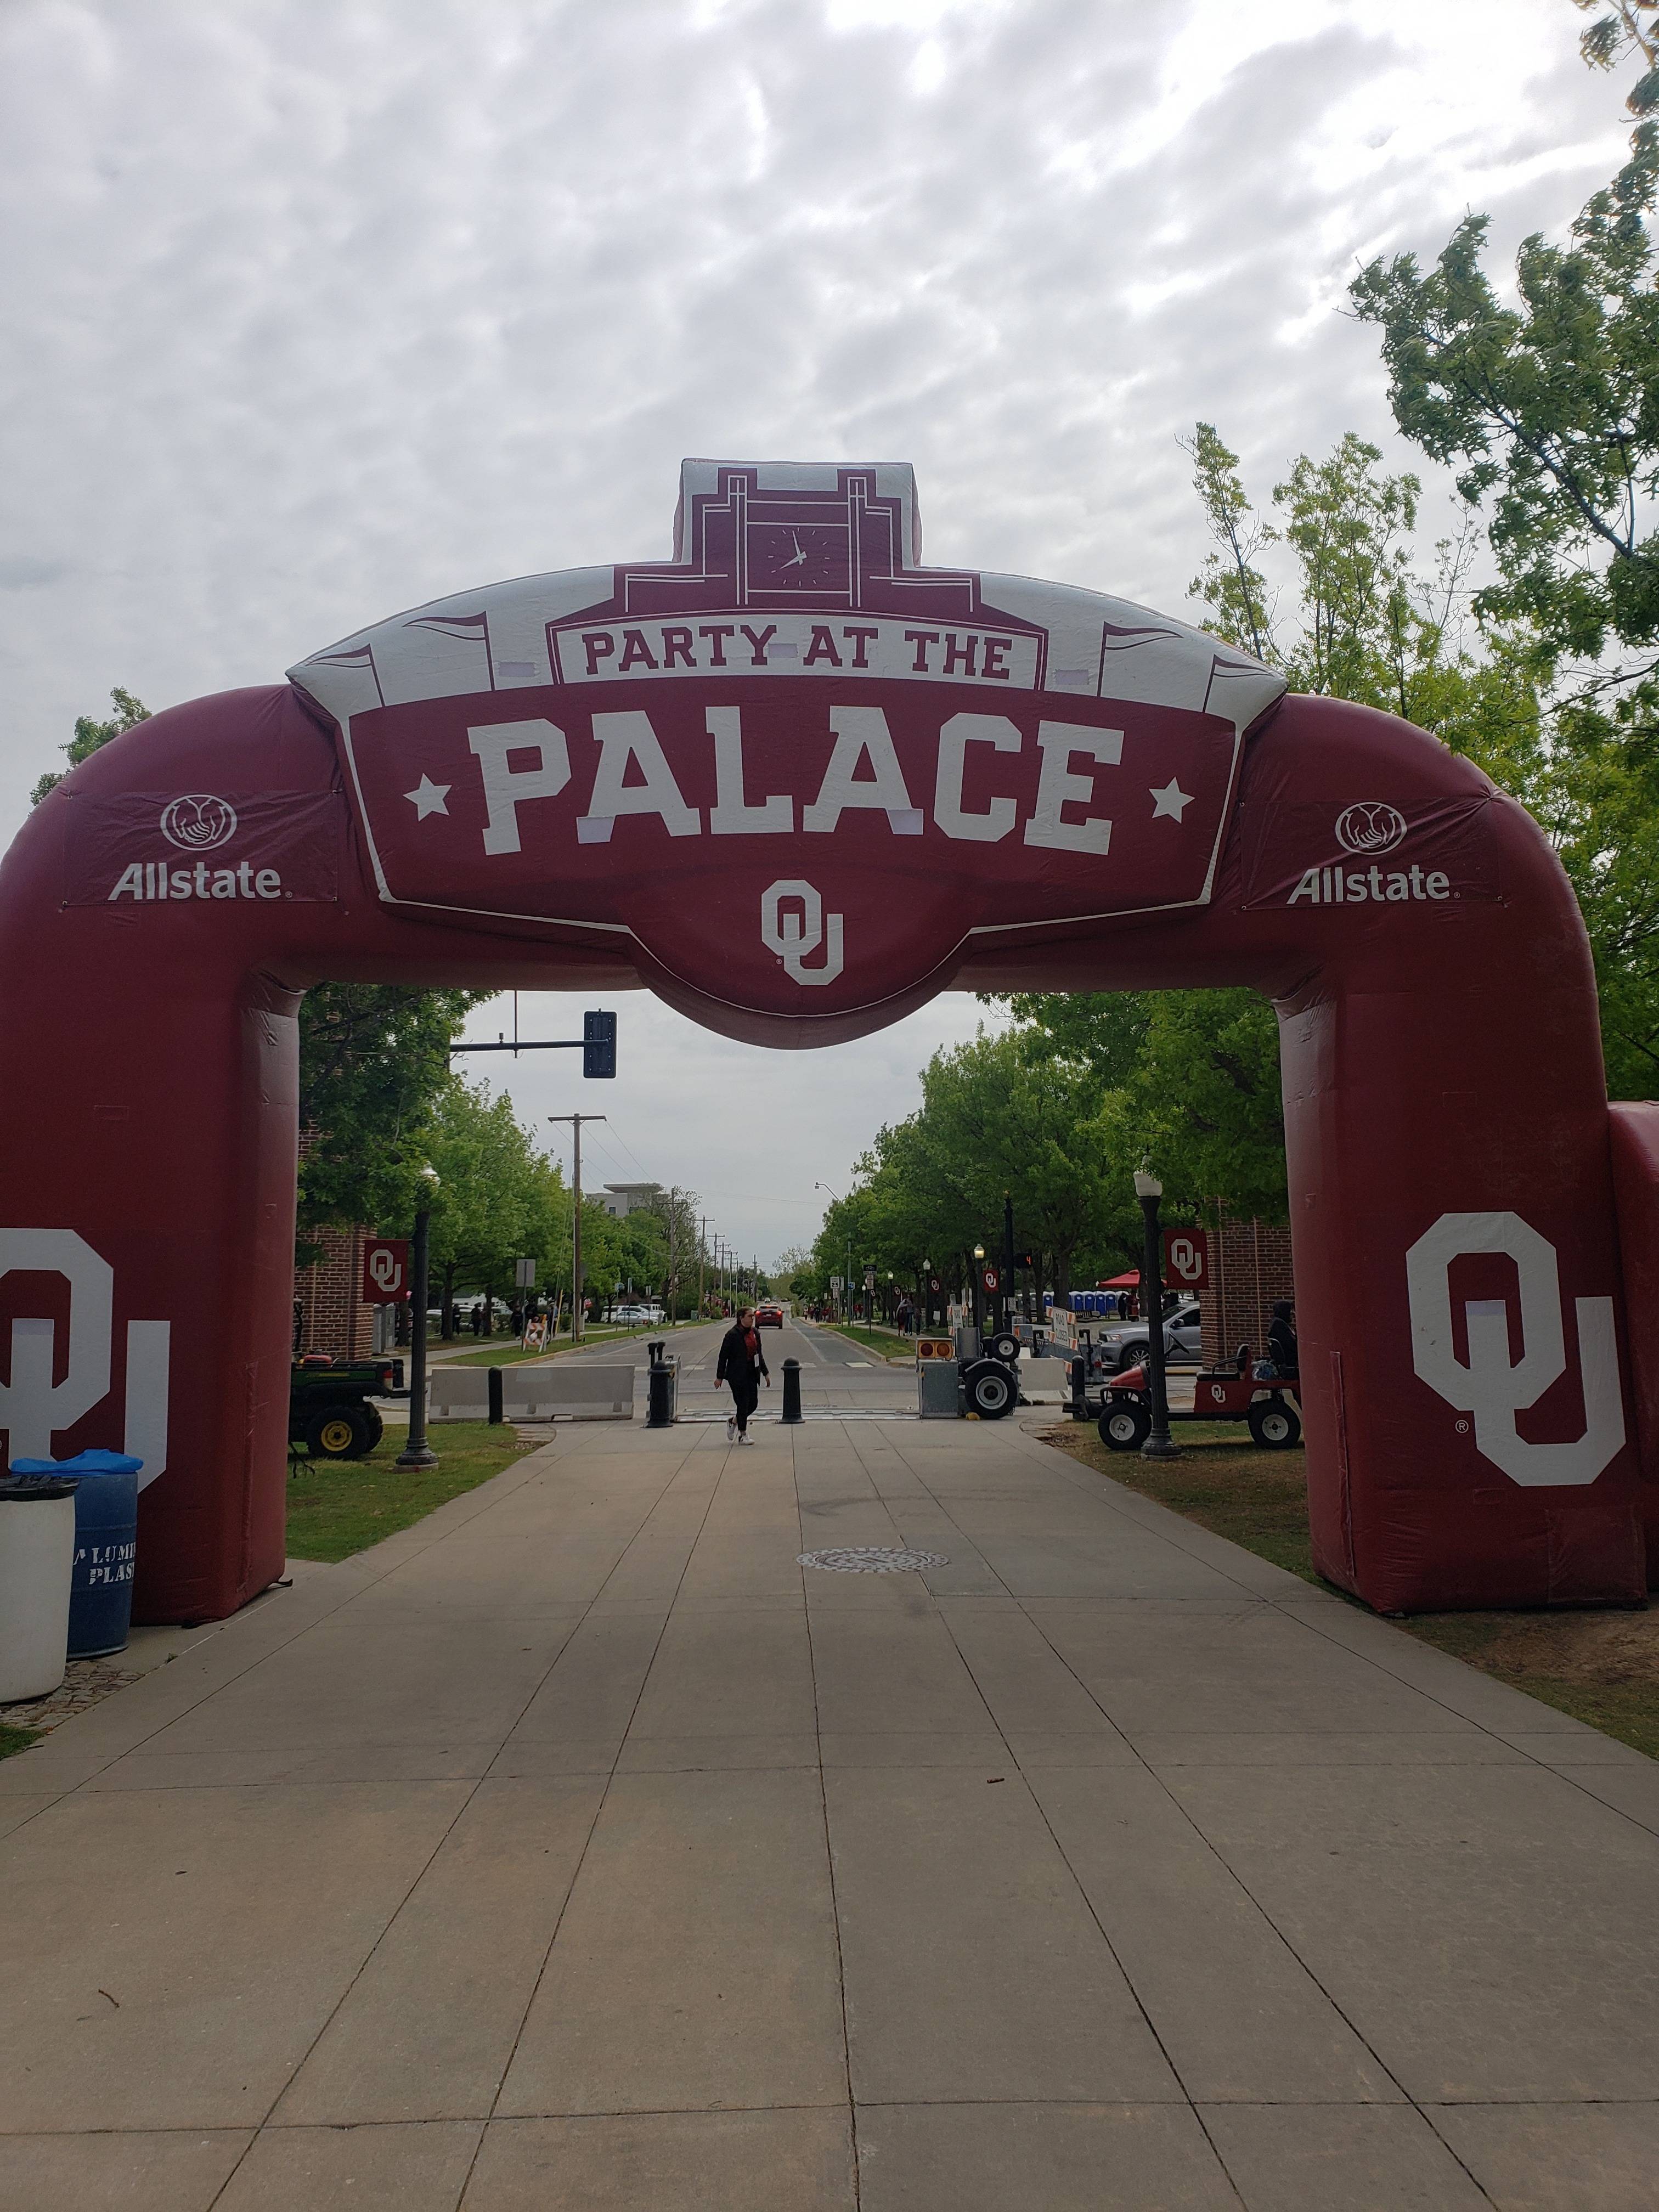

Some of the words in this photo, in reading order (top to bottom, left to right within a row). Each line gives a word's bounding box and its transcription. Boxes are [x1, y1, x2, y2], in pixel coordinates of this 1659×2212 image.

[581, 625, 777, 675] PARTY
[803, 625, 878, 668] AT
[905, 630, 1013, 680] THE
[466, 705, 1125, 856] PALACE
[107, 861, 282, 901] Allstate
[1286, 865, 1451, 905] Allstate
[761, 879, 844, 986] OU
[369, 1249, 402, 1292] OU
[1026, 1255, 1031, 1266] 4
[1171, 1238, 1202, 1280] OU
[985, 1273, 996, 1288] OU
[1055, 1312, 1065, 1327] ROAD
[1055, 1328, 1068, 1342] CLOSED
[1406, 1211, 1627, 1487] OU
[1211, 1384, 1226, 1403] OU
[88, 1561, 135, 1585] PLAS
